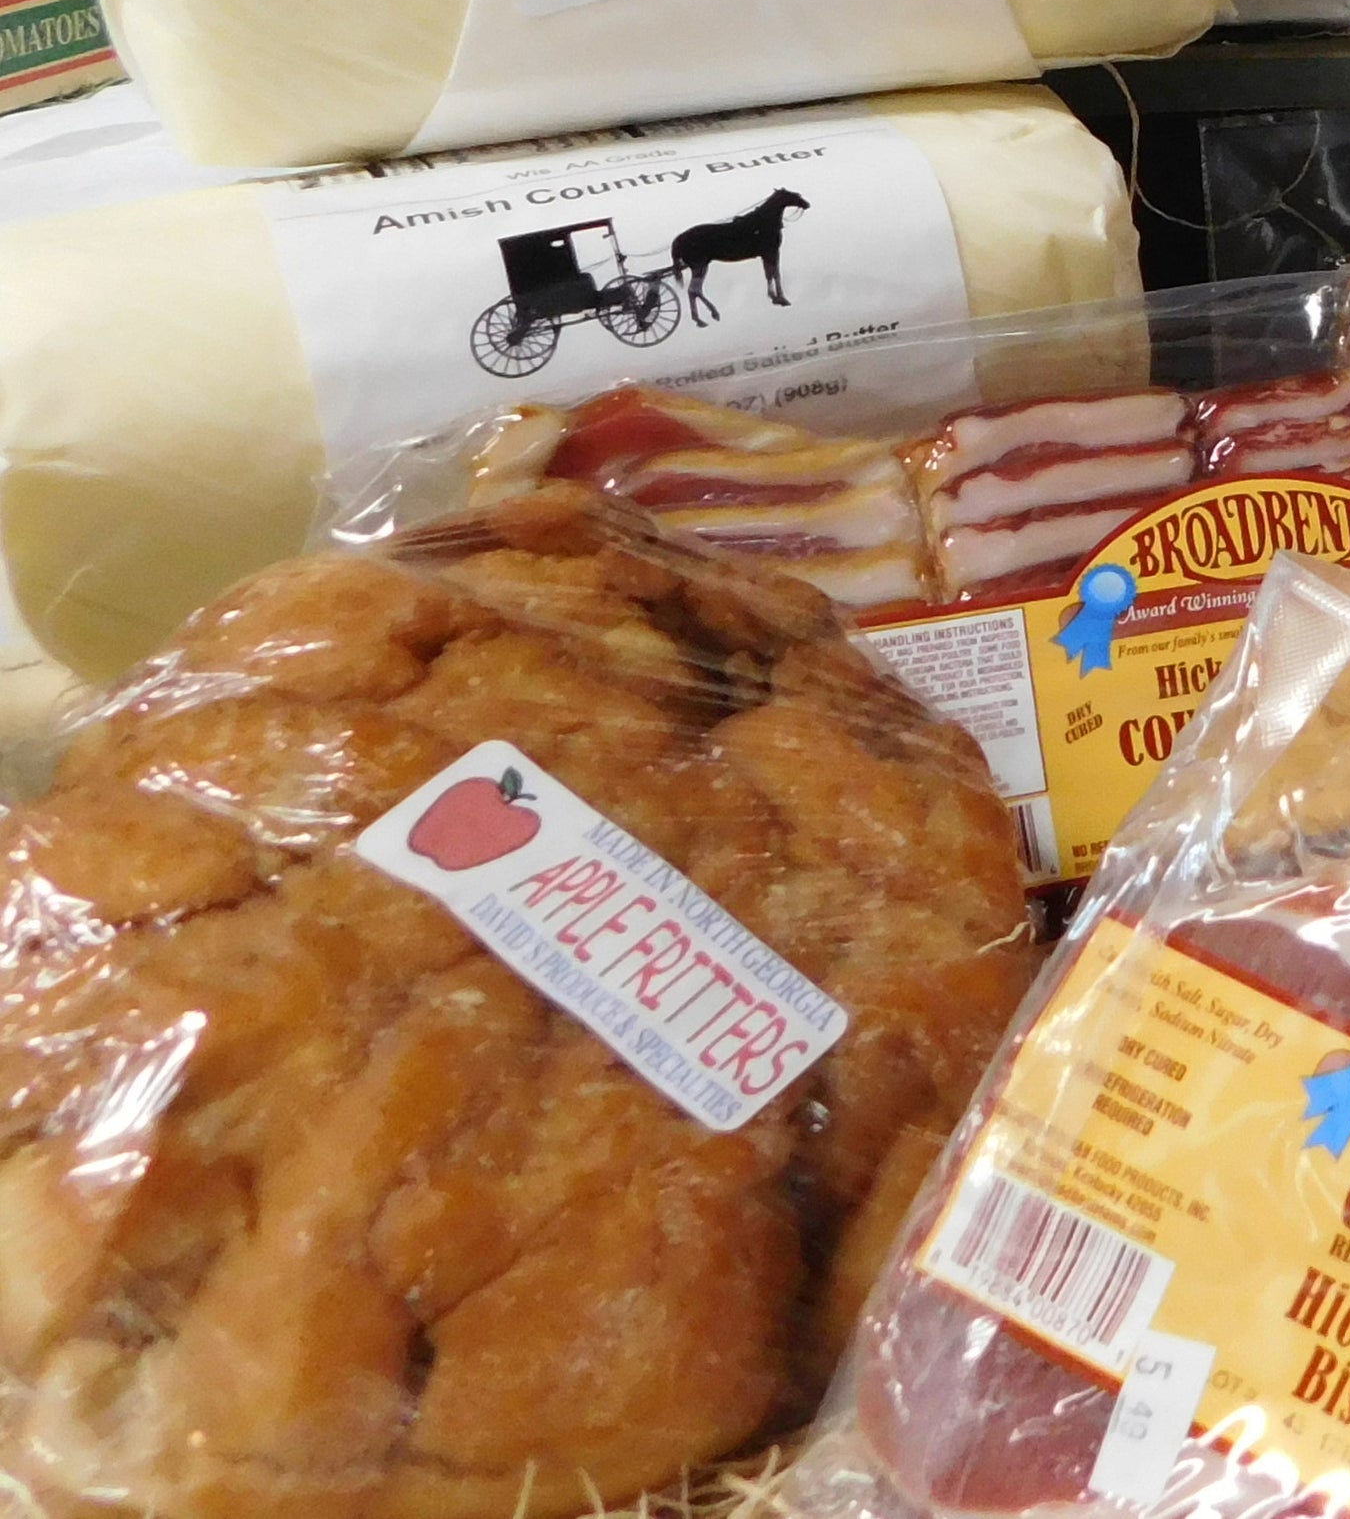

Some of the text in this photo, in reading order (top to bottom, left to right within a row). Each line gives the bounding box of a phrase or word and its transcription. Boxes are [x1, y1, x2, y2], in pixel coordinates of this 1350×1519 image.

[371, 143, 828, 236] Amish Country Butter
[1065, 714, 1104, 744] CURED
[1067, 701, 1094, 726] DRY
[582, 821, 843, 1033] MADE IN NORTH GEORGIA
[508, 855, 810, 1097] APPLE FRITTERS
